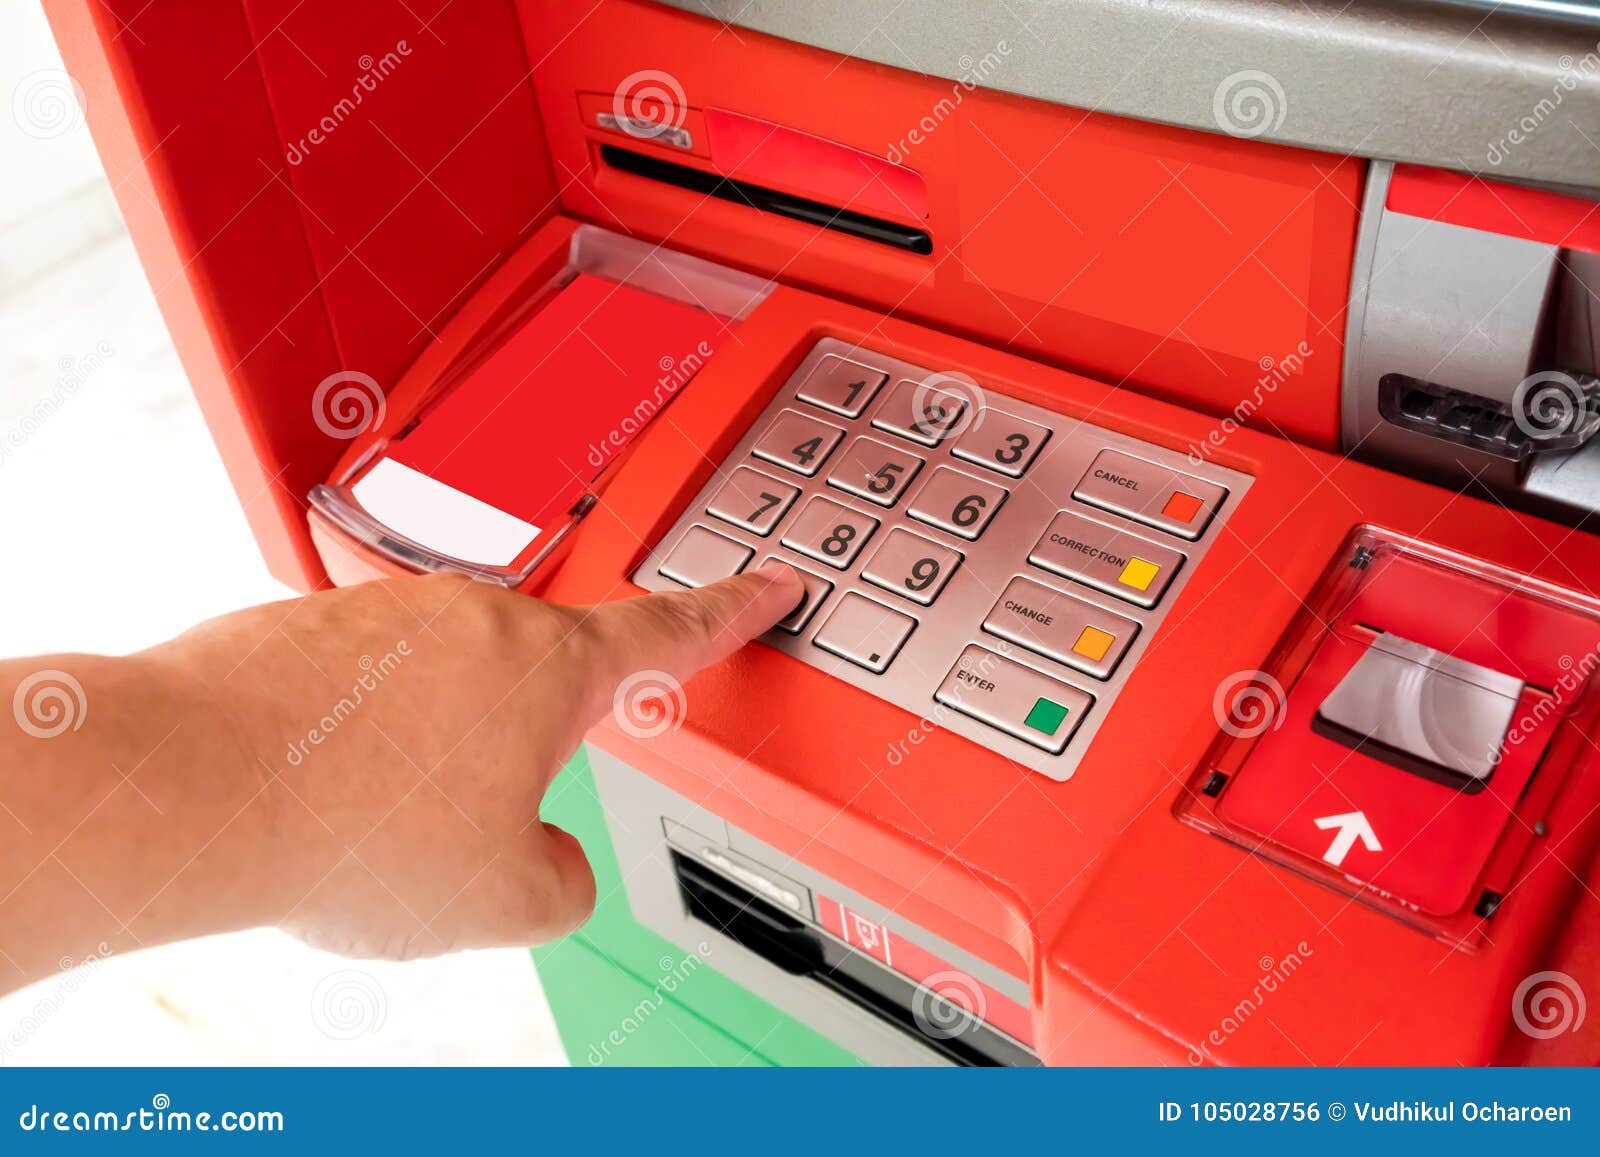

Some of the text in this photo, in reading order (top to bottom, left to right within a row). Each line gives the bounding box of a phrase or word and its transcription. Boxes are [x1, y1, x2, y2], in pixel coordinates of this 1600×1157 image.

[840, 380, 866, 407] 1
[910, 406, 947, 435] 2
[792, 435, 822, 464] 4
[996, 433, 1030, 465] 3
[868, 463, 904, 495] 5
[1094, 469, 1139, 491] CANCEL
[747, 492, 781, 521] 7
[952, 495, 987, 528] 6
[821, 524, 857, 557] 8
[1050, 533, 1126, 567] CORRECTION
[905, 558, 941, 591] 9
[1005, 600, 1052, 627] CHANGE
[956, 670, 996, 692] ENTER
